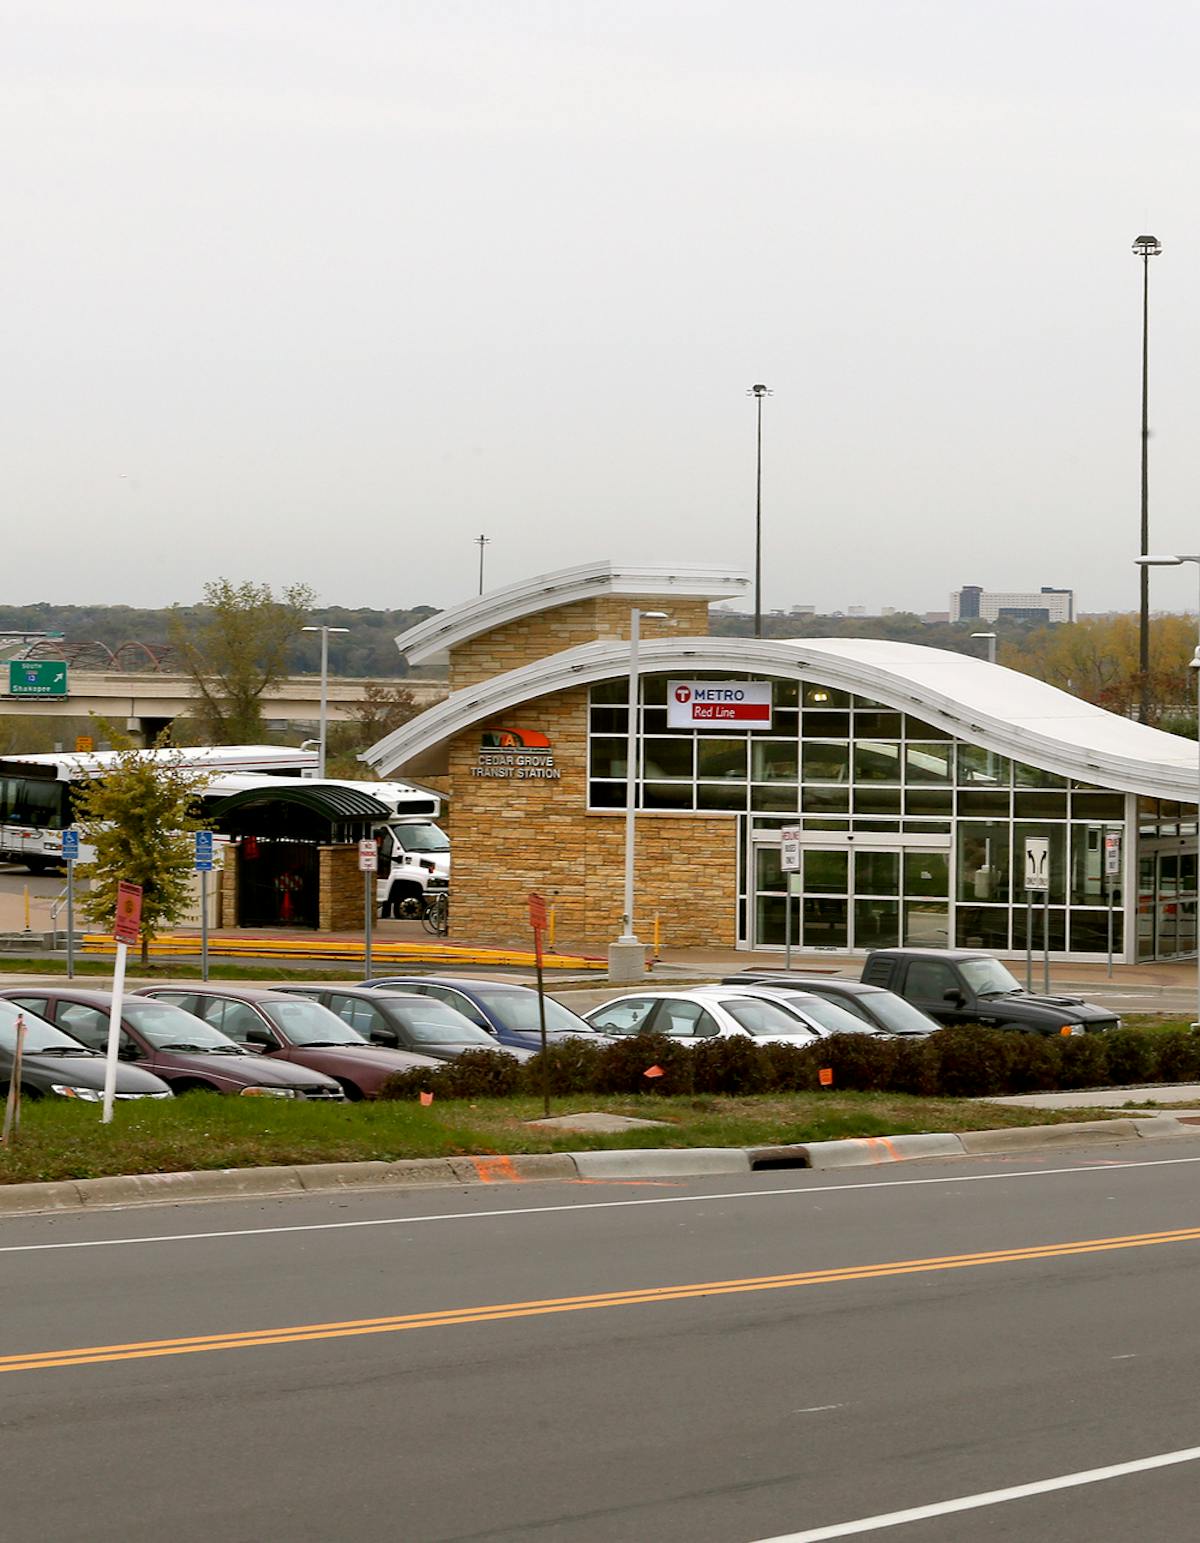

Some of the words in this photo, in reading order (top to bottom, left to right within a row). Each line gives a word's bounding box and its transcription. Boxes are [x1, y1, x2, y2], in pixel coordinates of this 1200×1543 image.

[694, 689, 744, 701] METRO
[694, 706, 713, 718] Red
[715, 706, 736, 718] Line
[478, 755, 514, 766] CEDAR
[516, 755, 554, 767] GROVE
[470, 767, 515, 778] TRANSIT
[517, 767, 561, 779] STATION
